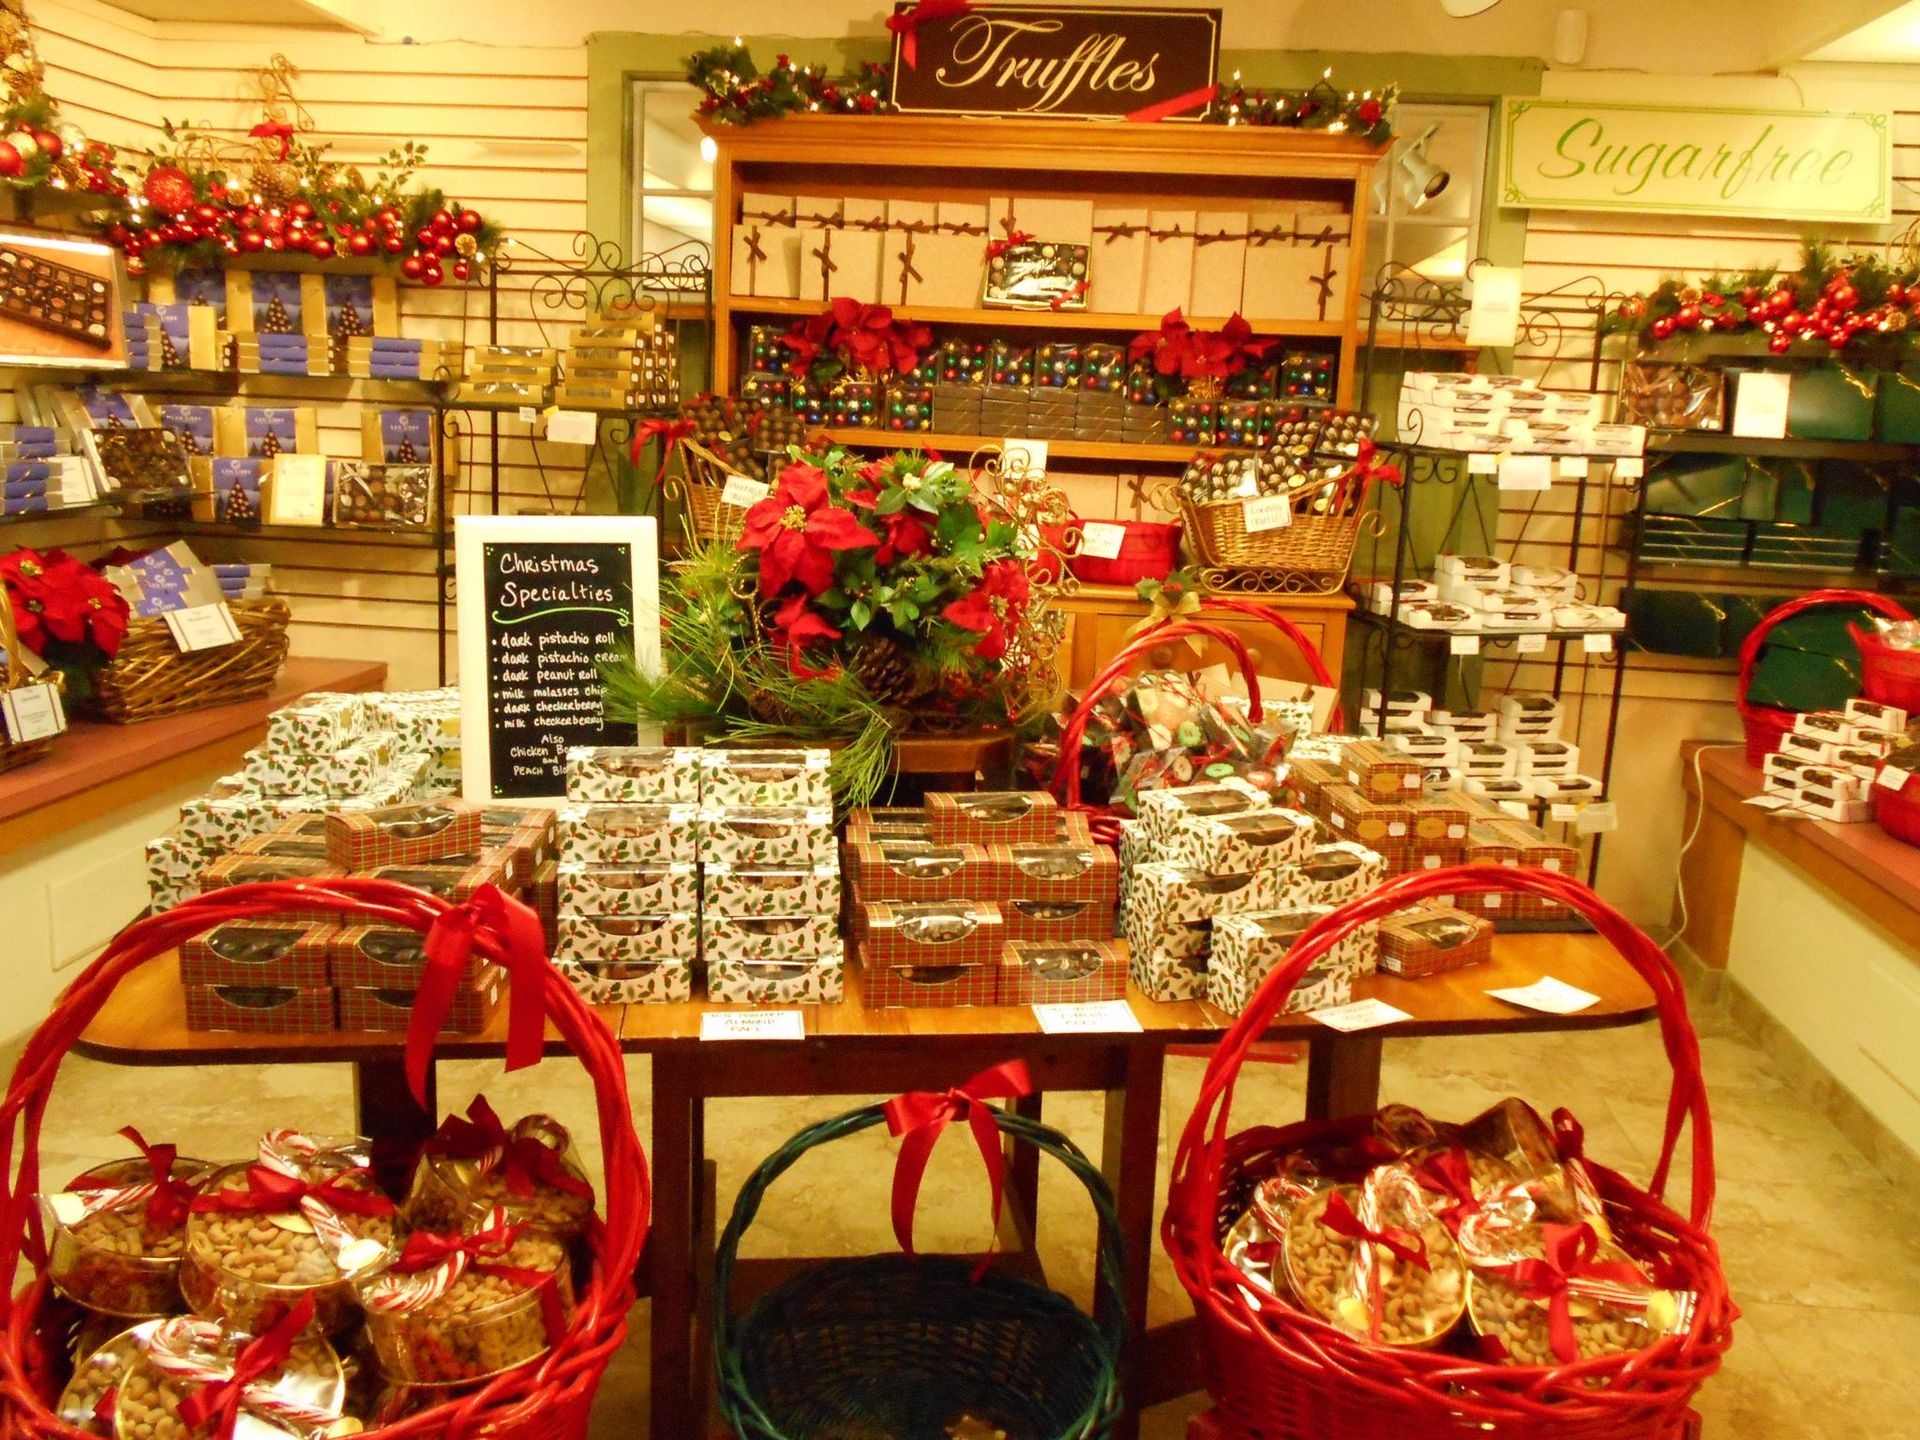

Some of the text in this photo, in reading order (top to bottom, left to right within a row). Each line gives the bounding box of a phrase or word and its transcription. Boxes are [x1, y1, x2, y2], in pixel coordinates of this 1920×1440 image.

[936, 15, 1160, 112] Truffles
[1538, 117, 1854, 200] Sugarfree
[500, 552, 599, 574] Christmas
[500, 581, 613, 608] Specialties
[501, 632, 532, 648] dark
[539, 631, 589, 651] pistachio
[501, 651, 529, 665] dark
[537, 651, 589, 668] pistachio
[503, 670, 529, 682] dark
[536, 668, 575, 683] peanut
[502, 687, 525, 699] milk
[533, 687, 579, 698] molasses
[504, 699, 604, 716] dark checkerberry
[504, 715, 604, 732] milk checkerberry
[541, 733, 565, 745] Also
[510, 745, 549, 758] Chicken
[542, 756, 558, 765] and
[513, 765, 544, 777] PEACH
